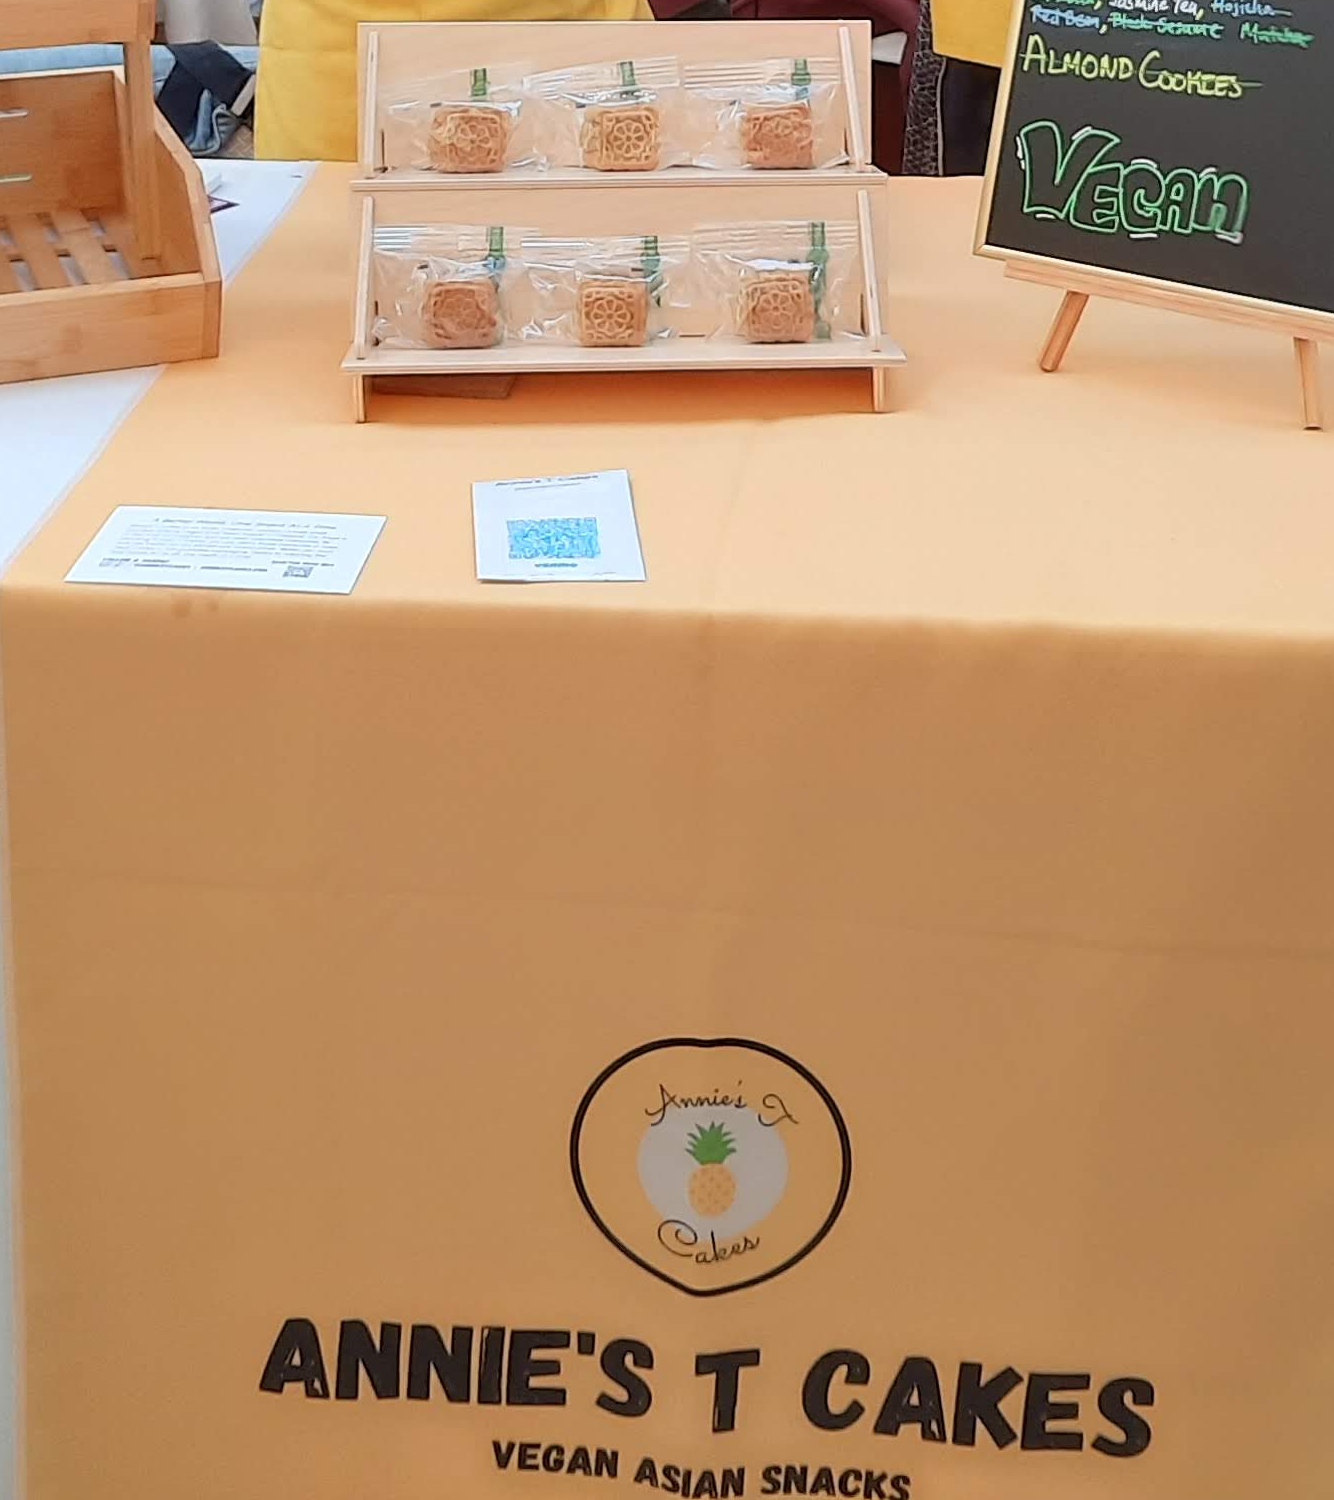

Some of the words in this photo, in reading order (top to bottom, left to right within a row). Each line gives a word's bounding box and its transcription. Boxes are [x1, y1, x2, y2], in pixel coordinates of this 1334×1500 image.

[1021, 34, 1134, 80] ALMOND
[645, 1080, 748, 1127] Annie's
[657, 1219, 760, 1264] Cakes
[259, 1317, 655, 1418] ANNIE'S
[695, 1348, 761, 1433] T
[801, 1348, 1155, 1458] CAKES
[491, 1440, 620, 1478] VEGAN
[633, 1457, 746, 1500] ASIAN
[760, 1463, 912, 1500] SNACKS
